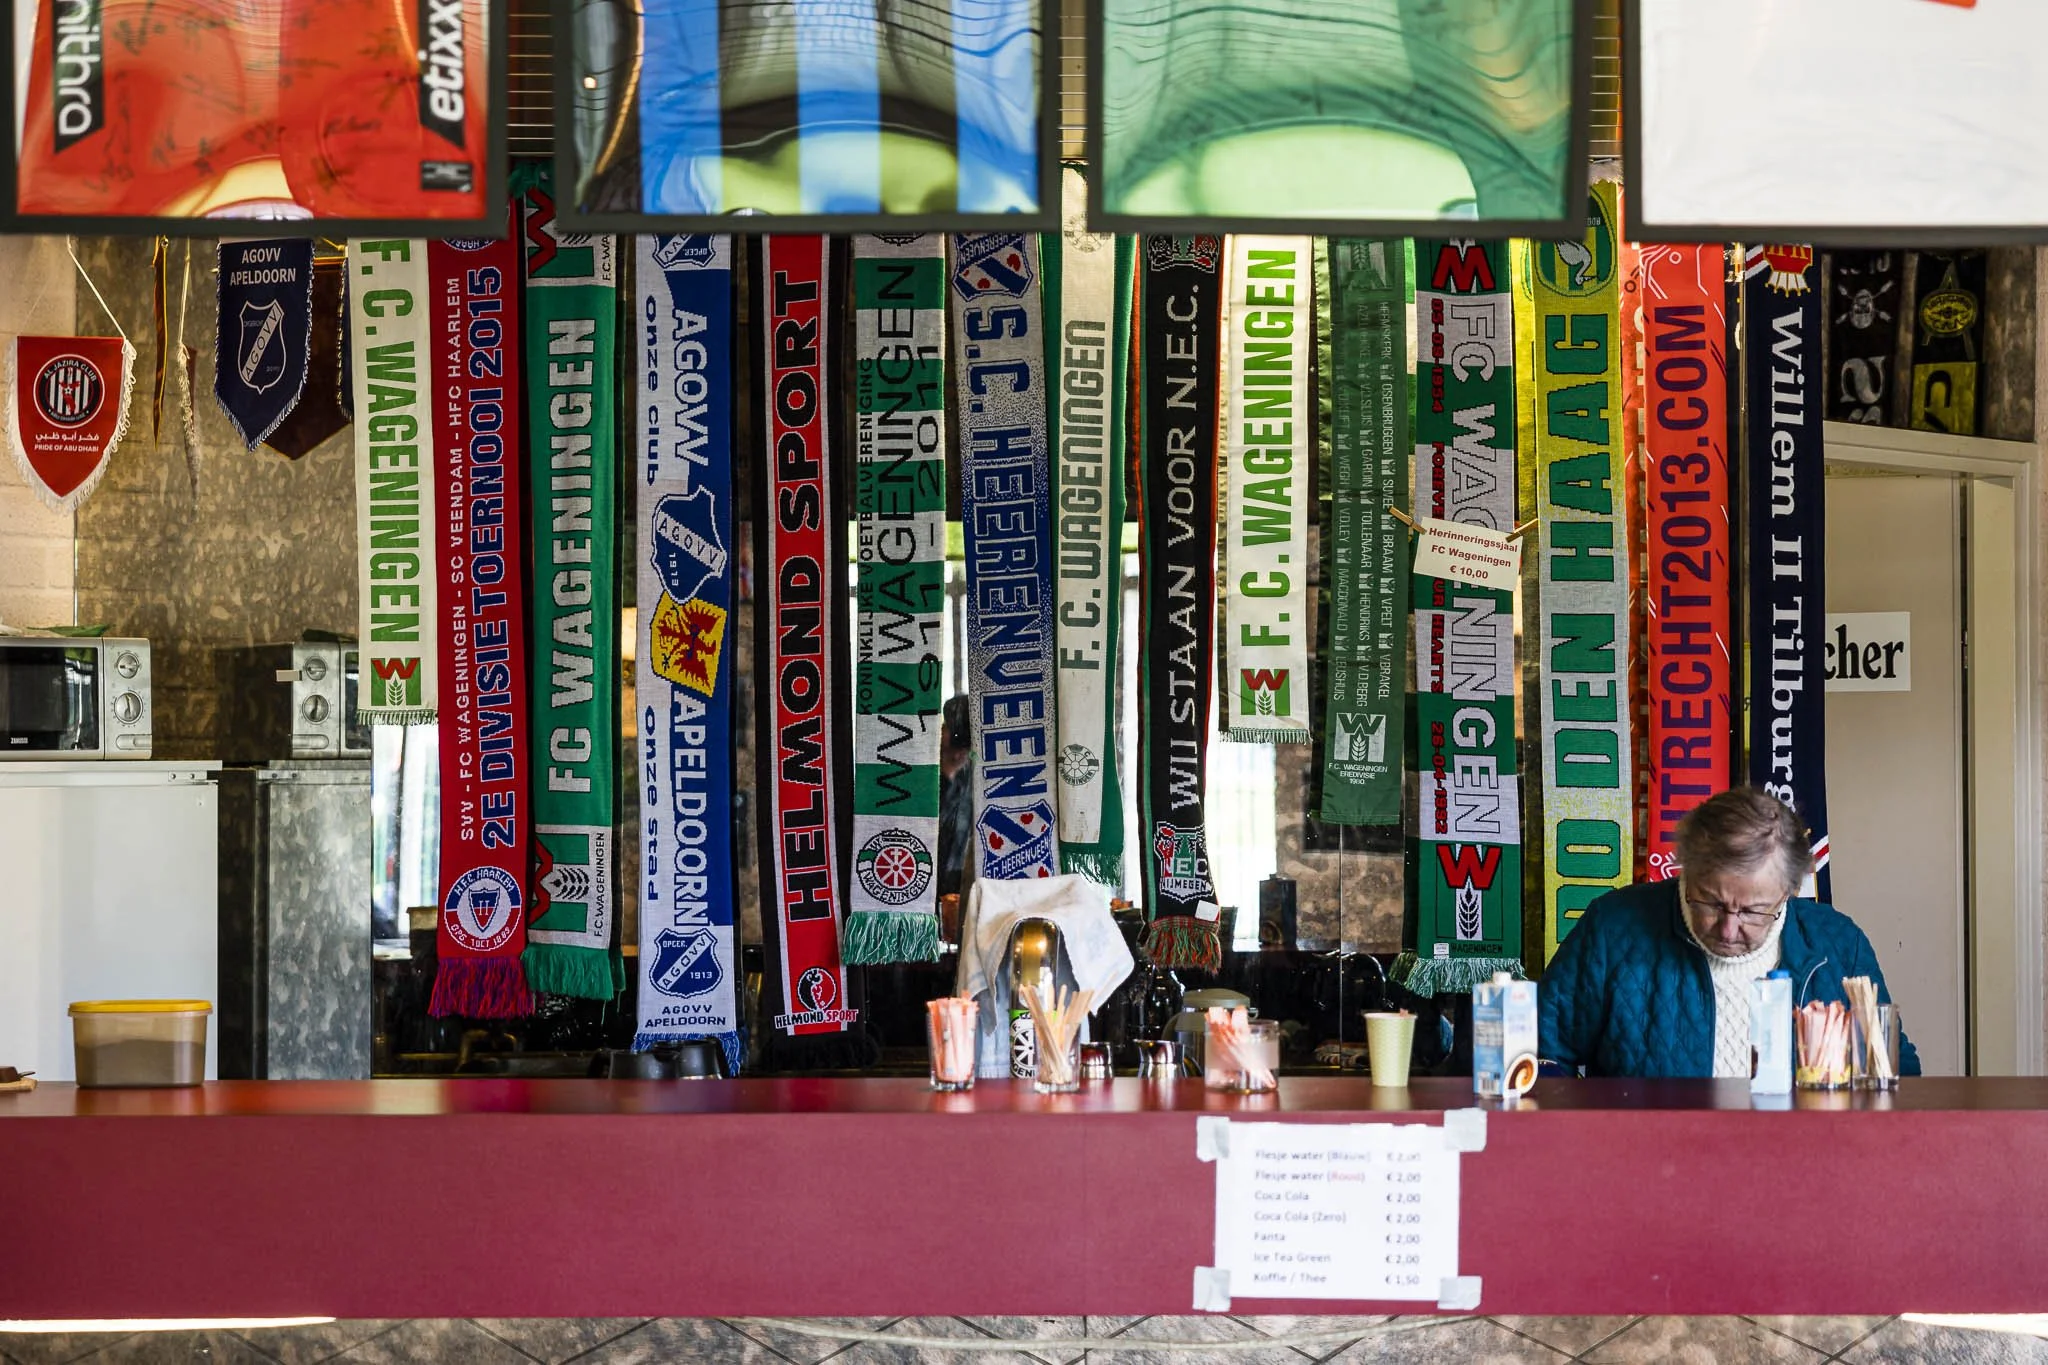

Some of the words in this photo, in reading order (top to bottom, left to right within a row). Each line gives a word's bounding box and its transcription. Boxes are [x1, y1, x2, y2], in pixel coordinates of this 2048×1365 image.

[230, 268, 296, 286] APELDOORN
[242, 248, 281, 265] AGOVV
[244, 308, 278, 380] AGOVV
[447, 278, 461, 377] HAARLEM
[468, 266, 503, 379] 2015
[645, 295, 659, 392] onze
[963, 305, 1031, 413] S.C.
[1166, 284, 1200, 409] N.E.C.
[1450, 302, 1496, 383] FC
[44, 368, 54, 379] AL
[54, 360, 79, 371] JAZIRA
[81, 364, 97, 382] CLUB
[448, 385, 462, 427] HFC
[672, 309, 709, 467] AGOVV
[772, 270, 820, 533] SPORT
[1242, 250, 1297, 547] WAGENINGEN
[647, 405, 660, 486] club
[917, 345, 940, 498] 2011
[1381, 383, 1394, 455] OSENBRUGGEN
[1545, 313, 1615, 582] HAAG
[1771, 307, 1805, 519] Willem
[858, 357, 874, 574] VOETBALVERENIGING
[876, 265, 917, 657] WAGENINGEN
[1060, 320, 1106, 580] WAGENINGEN
[1431, 441, 1445, 520] FOREVE
[450, 448, 464, 547] VEENDAM
[468, 388, 508, 616] TOERNOOI
[549, 319, 596, 708] WAGENINGEN
[1166, 426, 1197, 548] VOOR
[451, 555, 465, 583] SC
[657, 518, 719, 568] AGOVV
[1360, 509, 1373, 568] TOLLENAAR
[1381, 534, 1393, 573] BRAAM
[1429, 527, 1518, 553] Herinneringssjaal
[1431, 544, 1446, 555] FC
[1449, 547, 1512, 568] Wageningen
[1450, 565, 1457, 573] €
[1460, 567, 1489, 579] 10,00
[1771, 534, 1802, 582] II
[969, 424, 1048, 799] HEERENVEEN
[1338, 568, 1350, 630] MACDONALD
[1358, 592, 1370, 640] HENDRIKS
[453, 605, 471, 744] WAGENINGEN
[858, 580, 874, 715] KONINKLIJKE
[917, 583, 941, 732] 1911
[1168, 564, 1197, 727] STAAN
[1430, 614, 1445, 693] HEARTS
[474, 620, 515, 782] DIVISIE
[1551, 613, 1619, 788] DEN
[1764, 596, 1804, 814] Tilburg
[459, 752, 473, 779] FC
[548, 726, 592, 794] FC
[643, 705, 657, 807] onze
[779, 555, 833, 922] HELMOND
[875, 674, 916, 808] WVV
[1170, 737, 1200, 812] WIJ
[1343, 763, 1388, 773] WAGENINGEN
[460, 801, 474, 840] SVV
[481, 791, 516, 849] 2E
[672, 689, 709, 927] APELDOORN
[477, 868, 515, 892] HAARLEM
[647, 815, 659, 901] stad
[862, 871, 928, 903] WAGENINGEN
[1002, 835, 1050, 875] HEERENVEEN
[662, 936, 706, 988] AGOVV
[690, 971, 713, 979] 1913
[644, 1016, 727, 1029] APELDOORN
[662, 1004, 713, 1015] AGOVV
[775, 1011, 824, 1029] HELMOND
[825, 1009, 858, 1024] SPORT
[1291, 1151, 1323, 1160] water
[1291, 1172, 1323, 1180] water
[1396, 1171, 1421, 1183] 2,00
[1254, 1190, 1281, 1201] Coca
[1284, 1191, 1310, 1201] Cola
[1396, 1192, 1421, 1204] 2,00
[1254, 1211, 1281, 1221] Coca
[1284, 1212, 1309, 1222] Cola
[1312, 1211, 1347, 1223] (Zero)
[1396, 1213, 1420, 1225] 2,00
[1254, 1231, 1286, 1241] Fanta
[1395, 1233, 1420, 1245] 2,00
[1254, 1251, 1270, 1262] Ice
[1274, 1252, 1293, 1262] Tea
[1297, 1252, 1331, 1263] Green
[1395, 1254, 1420, 1265] 2,00
[1254, 1272, 1287, 1283] Koffie
[1300, 1273, 1328, 1283] Thee
[1395, 1274, 1420, 1286] 1,50
